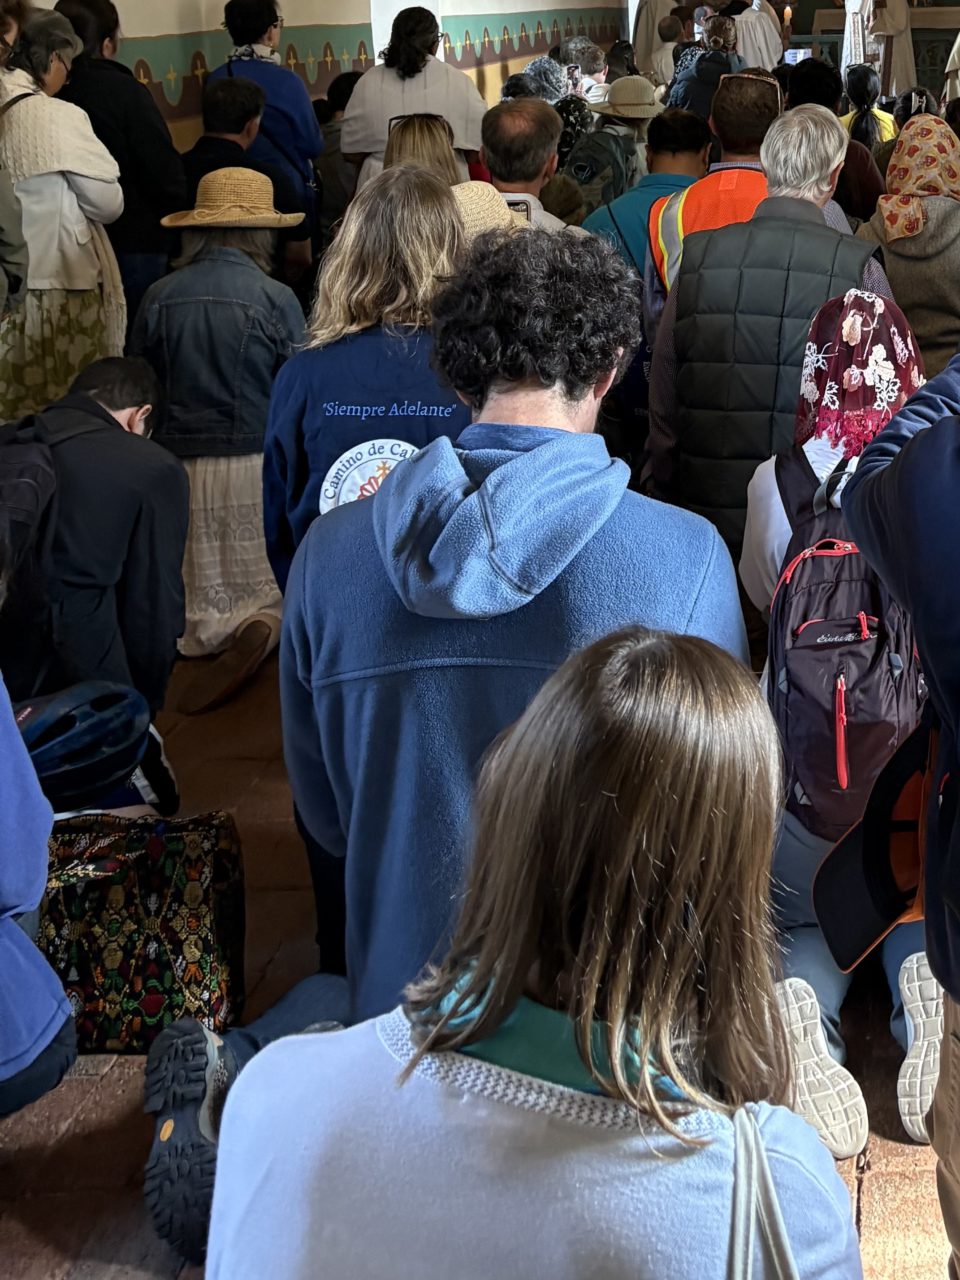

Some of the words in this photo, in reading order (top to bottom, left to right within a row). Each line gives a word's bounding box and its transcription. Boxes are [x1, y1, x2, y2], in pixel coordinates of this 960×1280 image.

[322, 401, 385, 420] "Siempre
[388, 400, 457, 418] Adelante"
[323, 451, 363, 500] Camino
[367, 442, 385, 457] de
[390, 443, 416, 459] Cal
